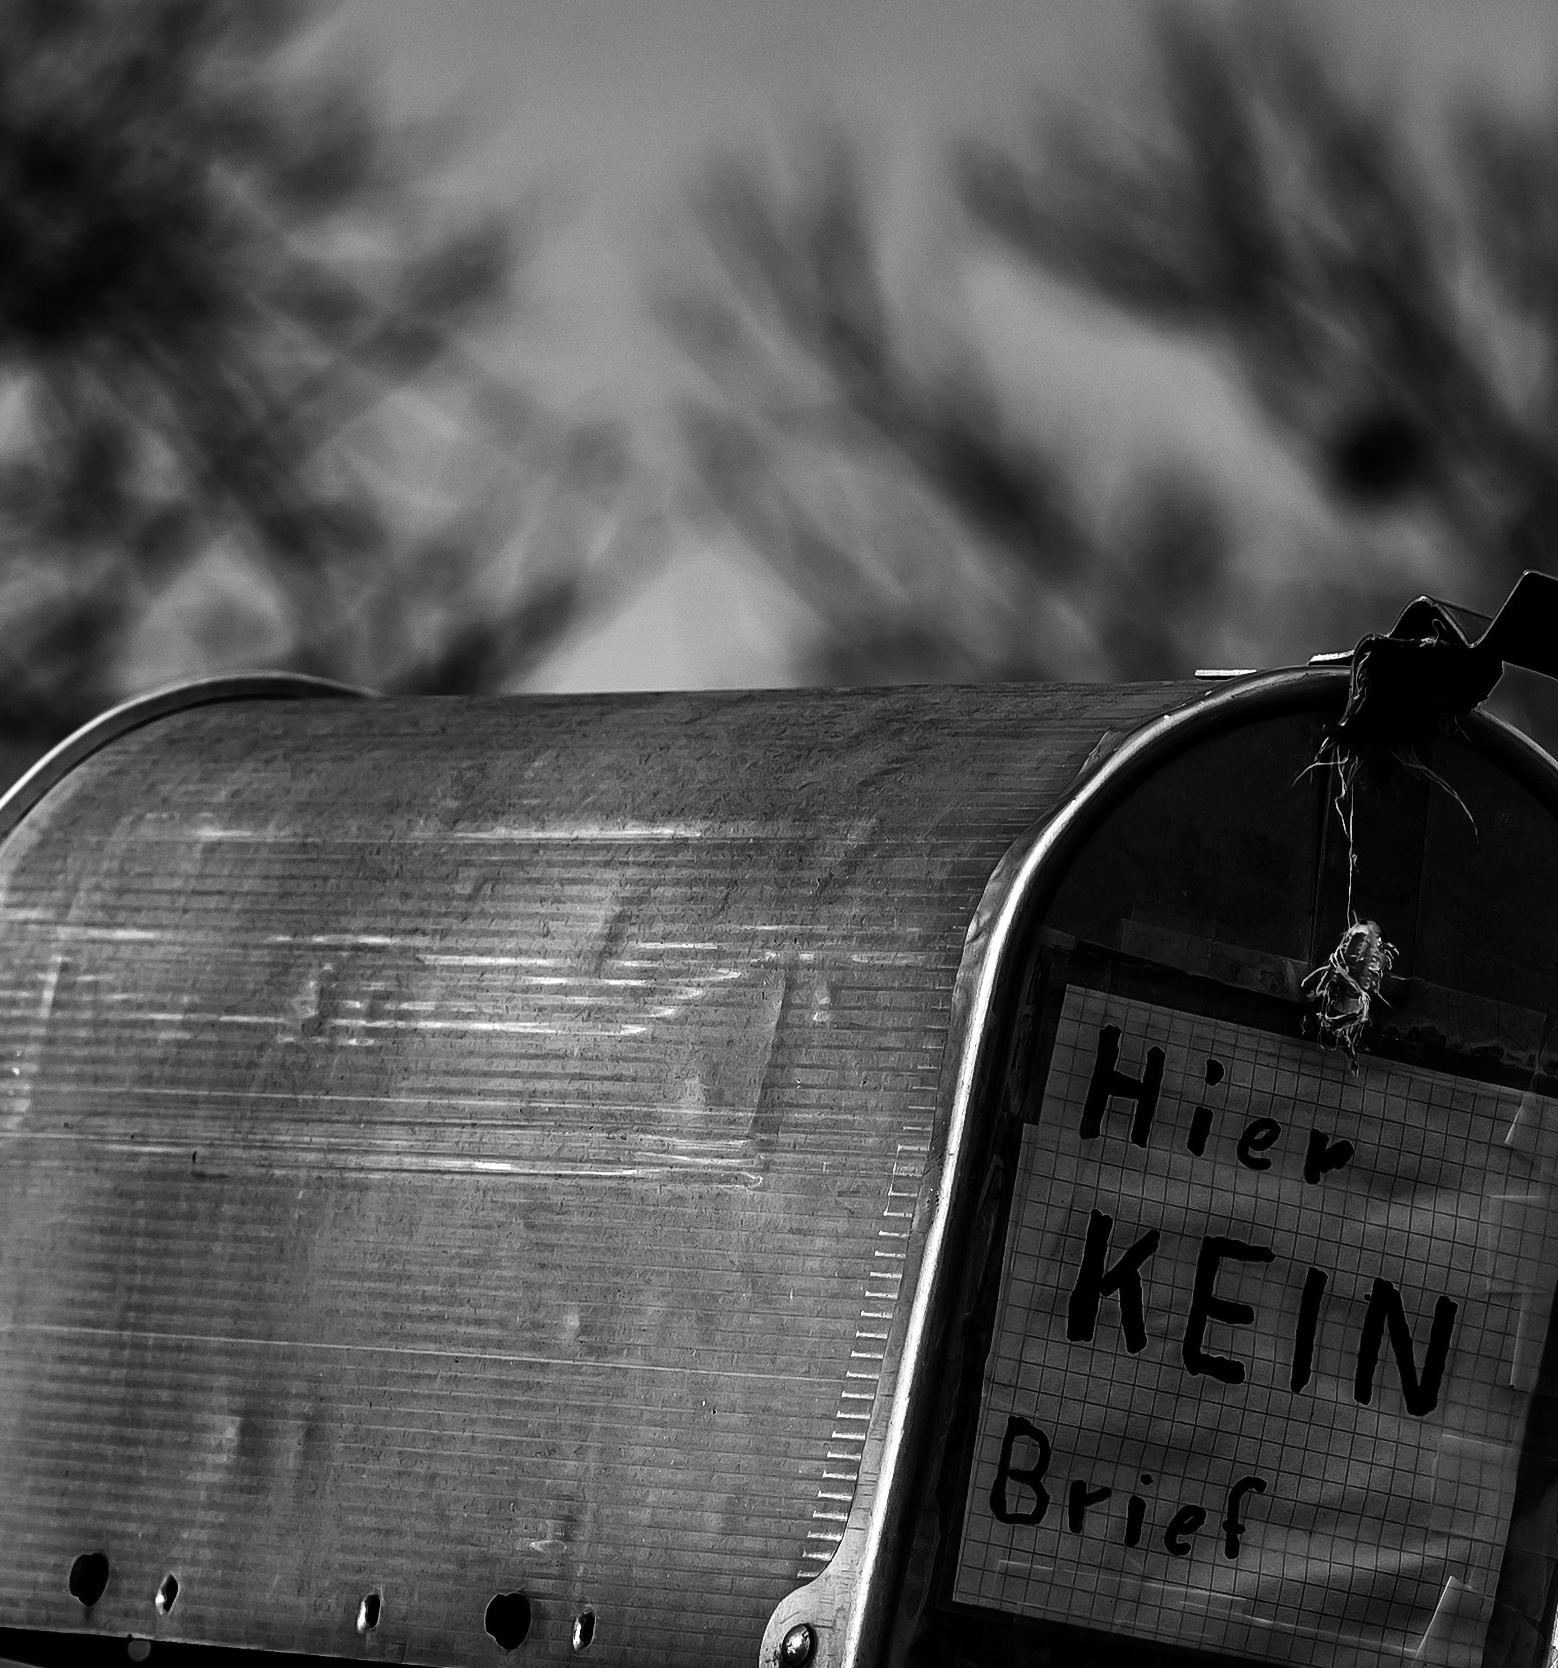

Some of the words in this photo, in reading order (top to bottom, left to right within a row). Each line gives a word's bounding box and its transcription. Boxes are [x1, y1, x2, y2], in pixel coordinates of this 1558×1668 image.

[1081, 1025, 1354, 1184] Hier
[1067, 1209, 1458, 1416] KEIN
[989, 1417, 1267, 1559] Brief
